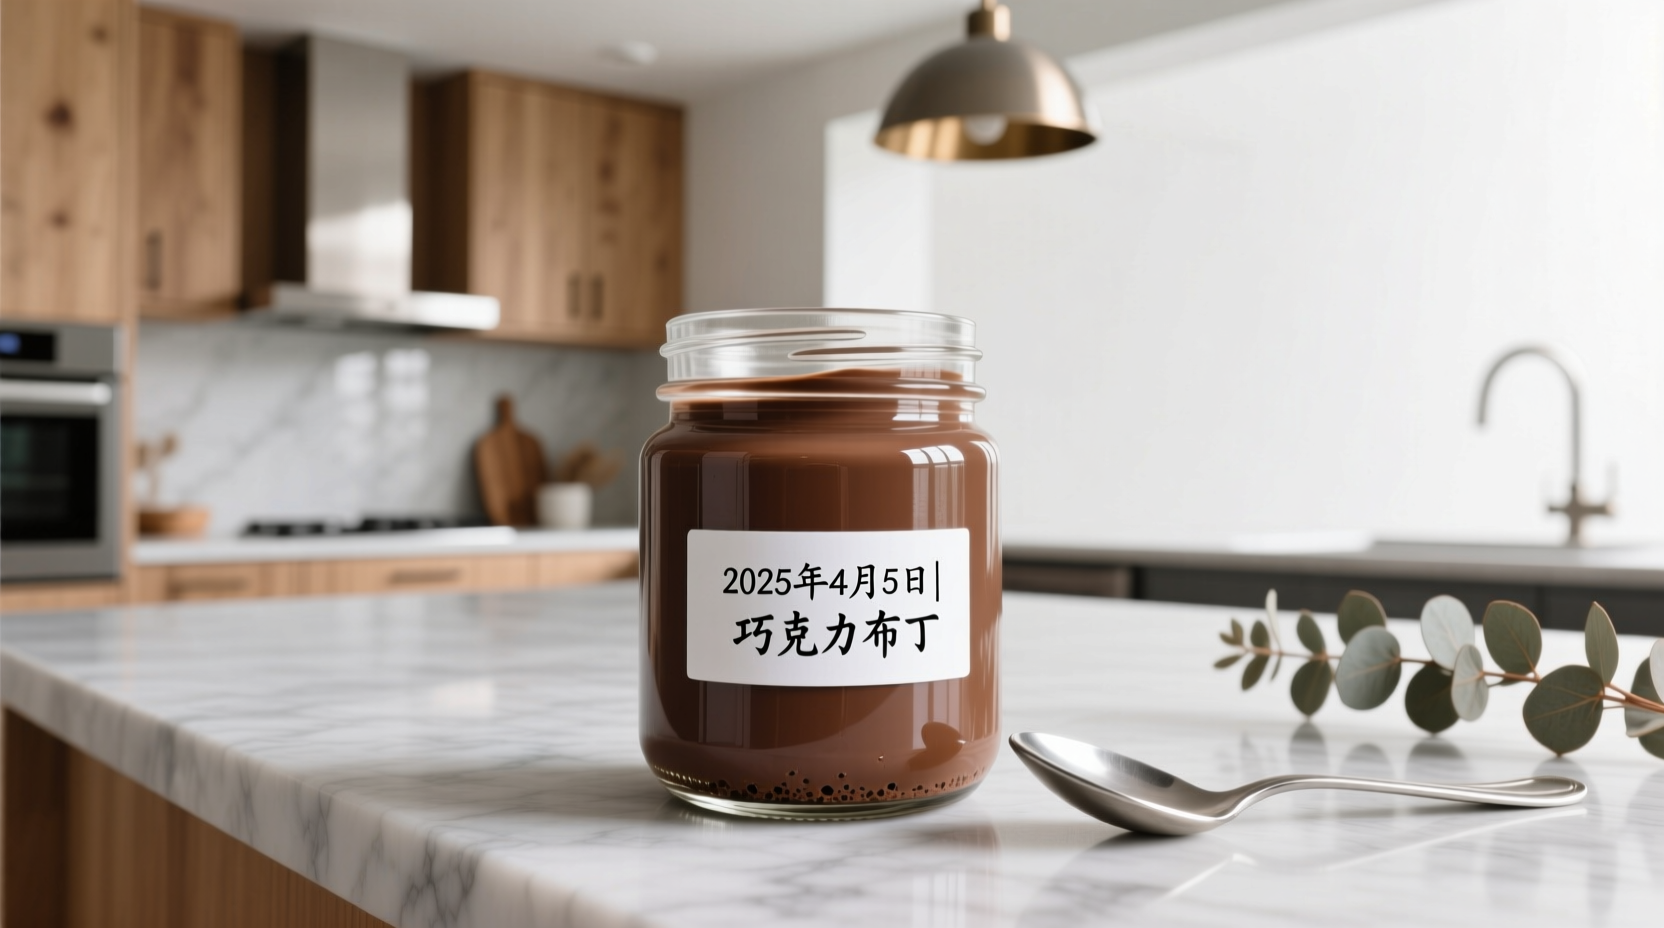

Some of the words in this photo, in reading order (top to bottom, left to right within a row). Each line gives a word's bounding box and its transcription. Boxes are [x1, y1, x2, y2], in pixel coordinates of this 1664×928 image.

[732, 609, 940, 659] 巧克力布丁
